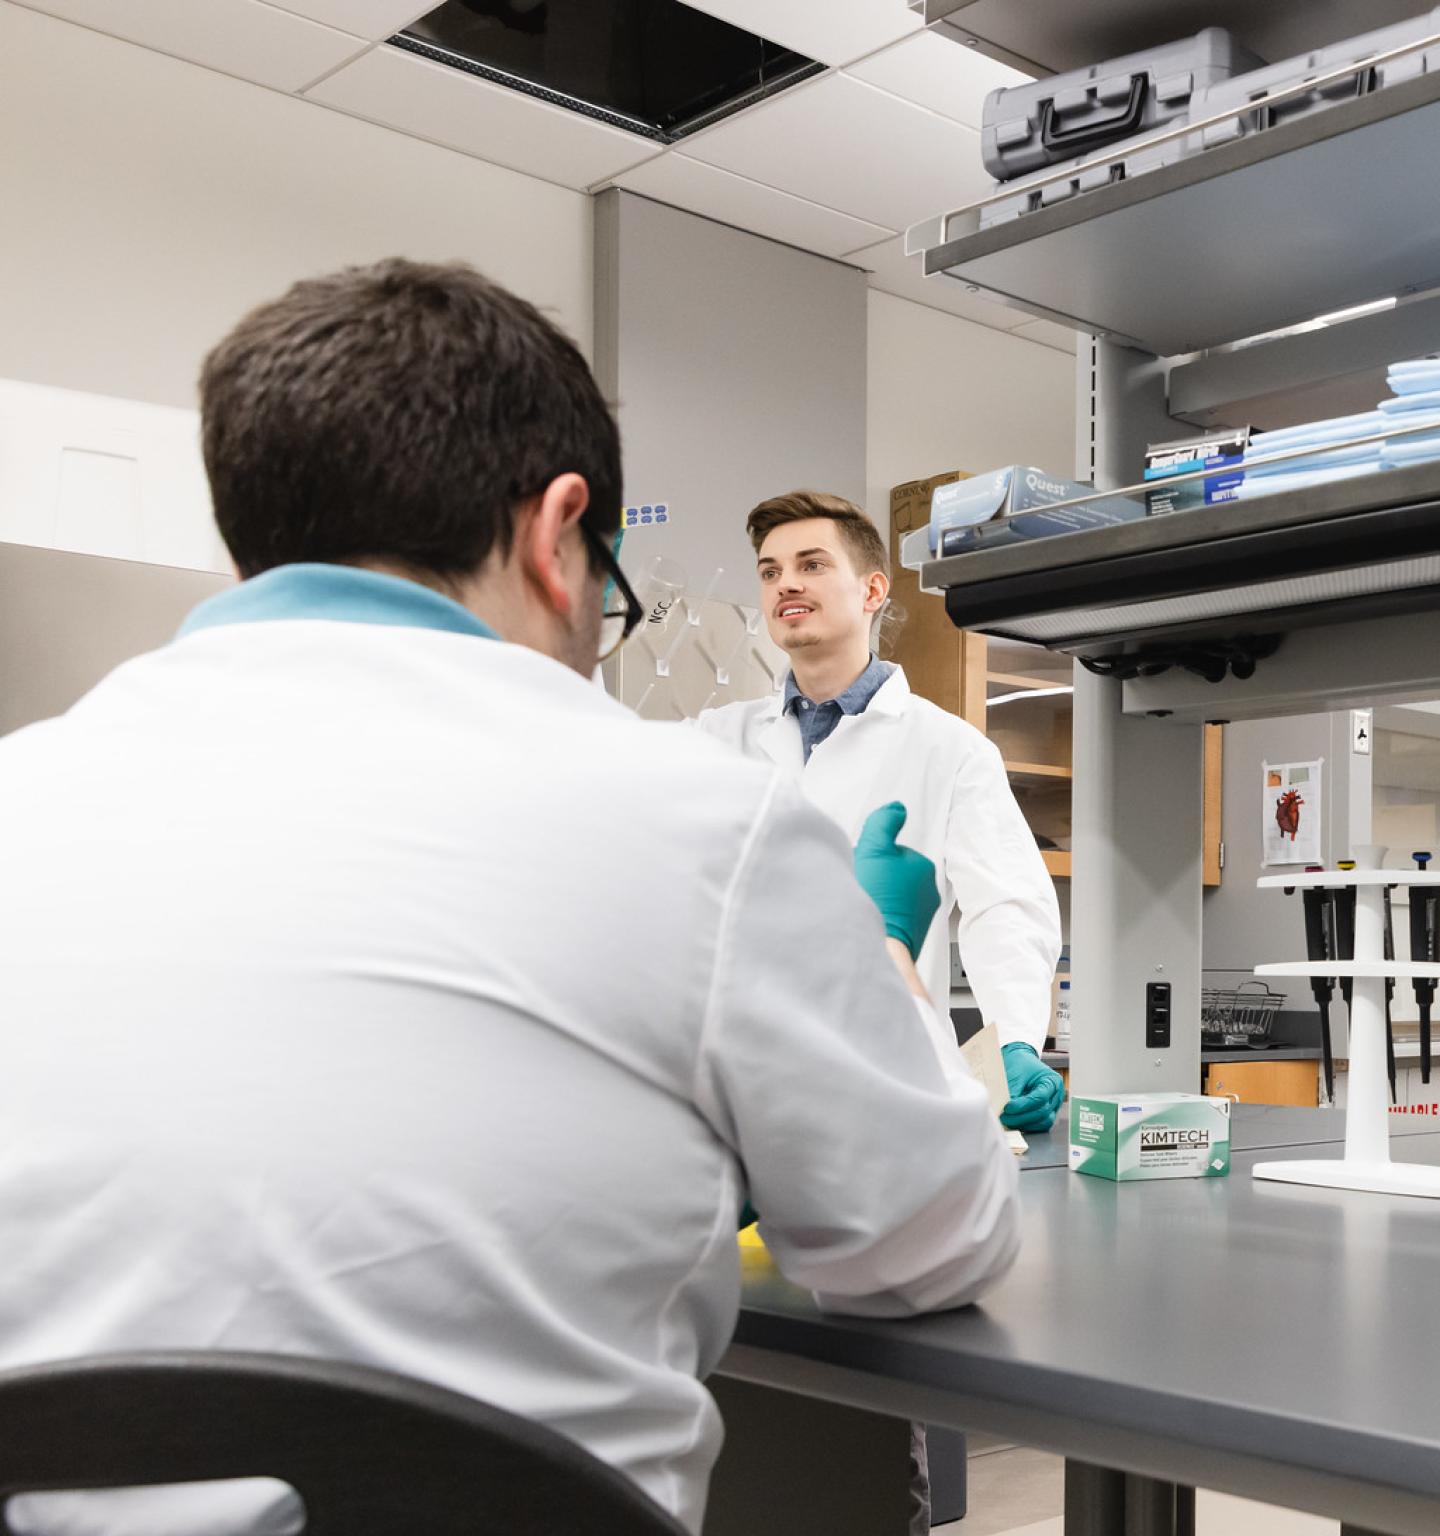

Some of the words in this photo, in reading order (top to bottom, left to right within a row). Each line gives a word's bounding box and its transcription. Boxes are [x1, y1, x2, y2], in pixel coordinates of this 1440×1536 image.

[1026, 473, 1067, 497] Quest
[648, 601, 672, 624] NSC
[1141, 1130, 1209, 1145] KIMTECH
